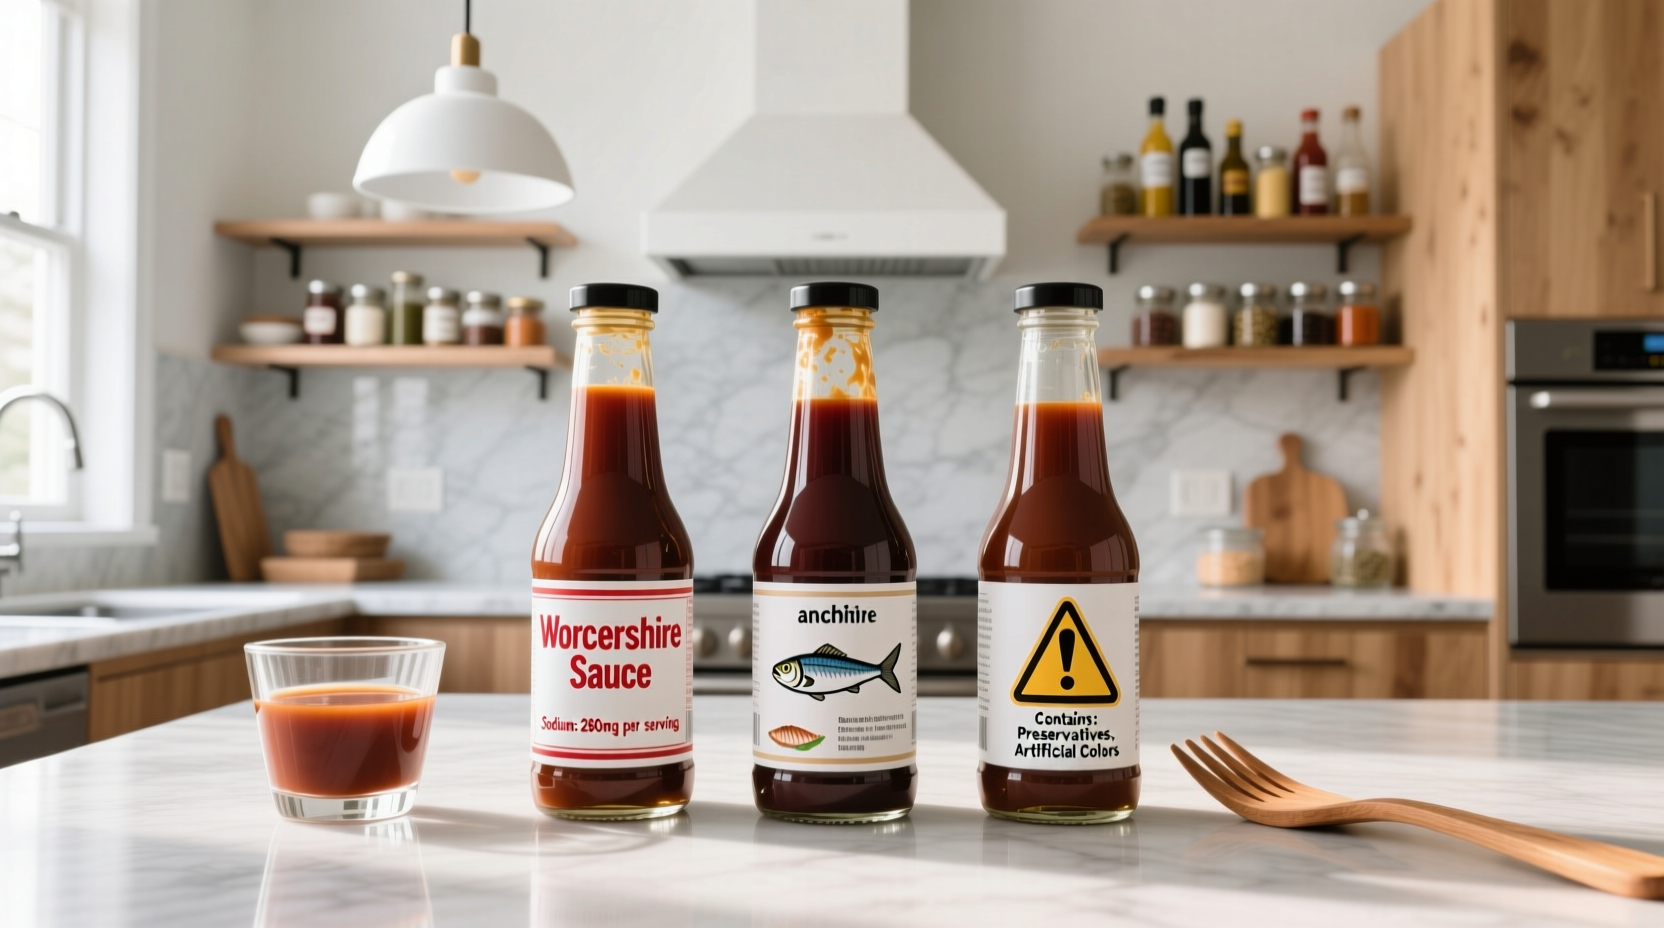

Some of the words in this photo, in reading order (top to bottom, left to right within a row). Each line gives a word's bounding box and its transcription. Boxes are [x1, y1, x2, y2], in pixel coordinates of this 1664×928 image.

[540, 614, 682, 650] Worcershire
[570, 654, 652, 689] Sauce
[541, 716, 578, 732] Sodium:
[623, 721, 640, 737] per
[644, 715, 680, 733] serving
[1034, 711, 1098, 726] Contains:
[1017, 726, 1115, 742] Preservatives,
[1080, 743, 1120, 759] Colors
